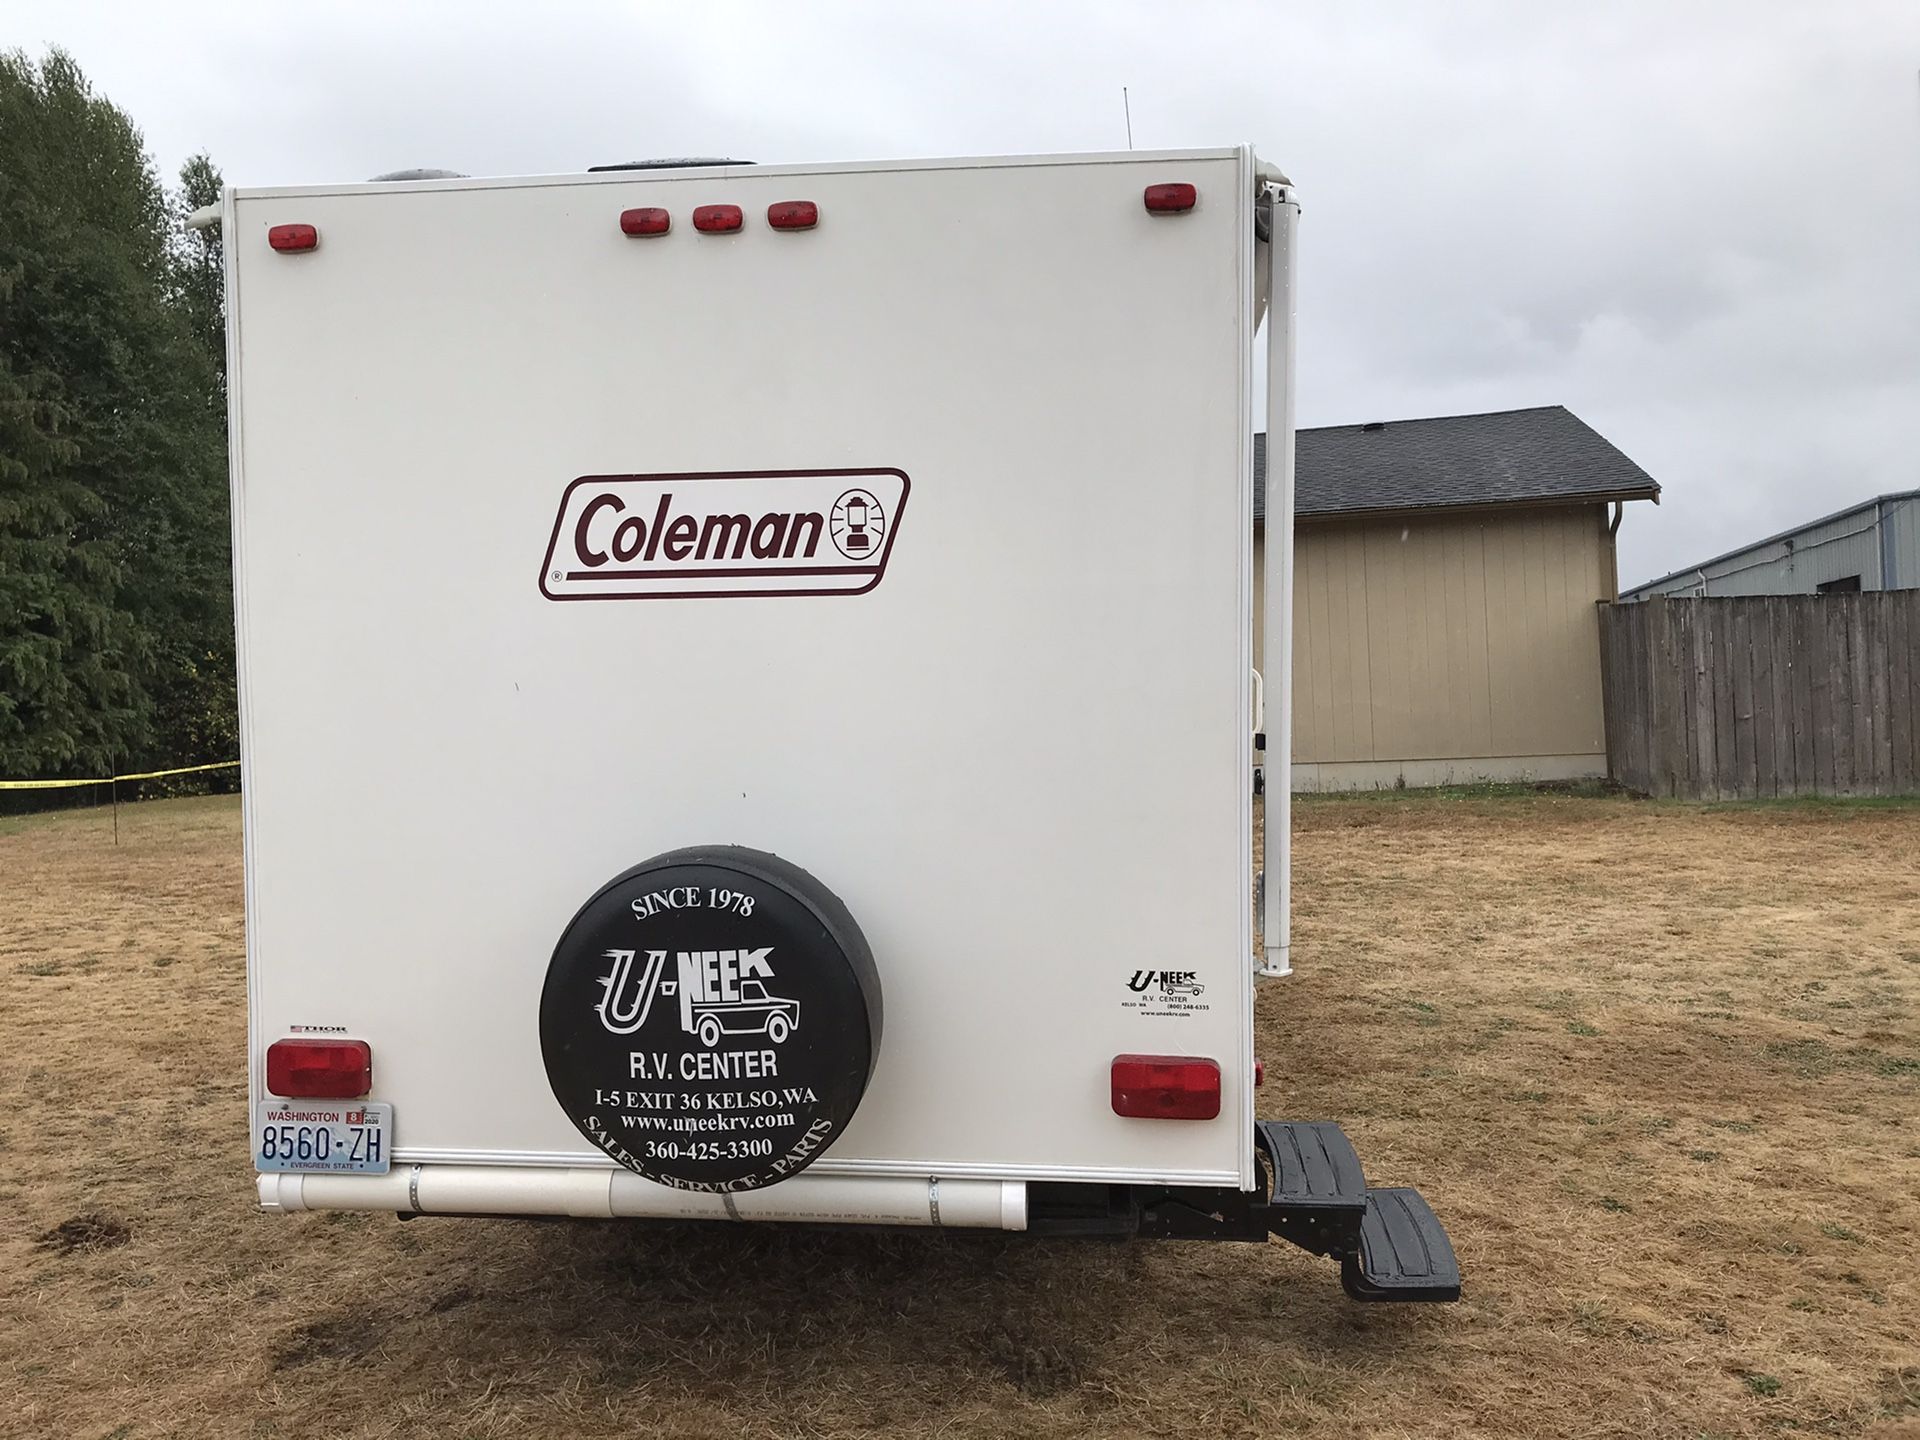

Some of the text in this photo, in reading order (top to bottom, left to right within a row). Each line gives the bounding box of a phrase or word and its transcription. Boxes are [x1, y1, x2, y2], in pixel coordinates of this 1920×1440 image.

[574, 493, 824, 567] Coleman
[631, 887, 756, 920] SINCE 1978
[1159, 995, 1188, 1003] CENTER
[629, 1050, 778, 1081] R.V. CENTER
[594, 1088, 621, 1106] I-5
[626, 1091, 675, 1110] EXIT
[680, 1092, 701, 1110] 36
[267, 1111, 340, 1123] WASHINGTON
[621, 1112, 795, 1132] www.uneekrv.com
[583, 1115, 833, 1193] SALES SERVICE PARTS
[645, 1138, 773, 1161] 360-425-3300
[333, 1162, 354, 1170] STATE
